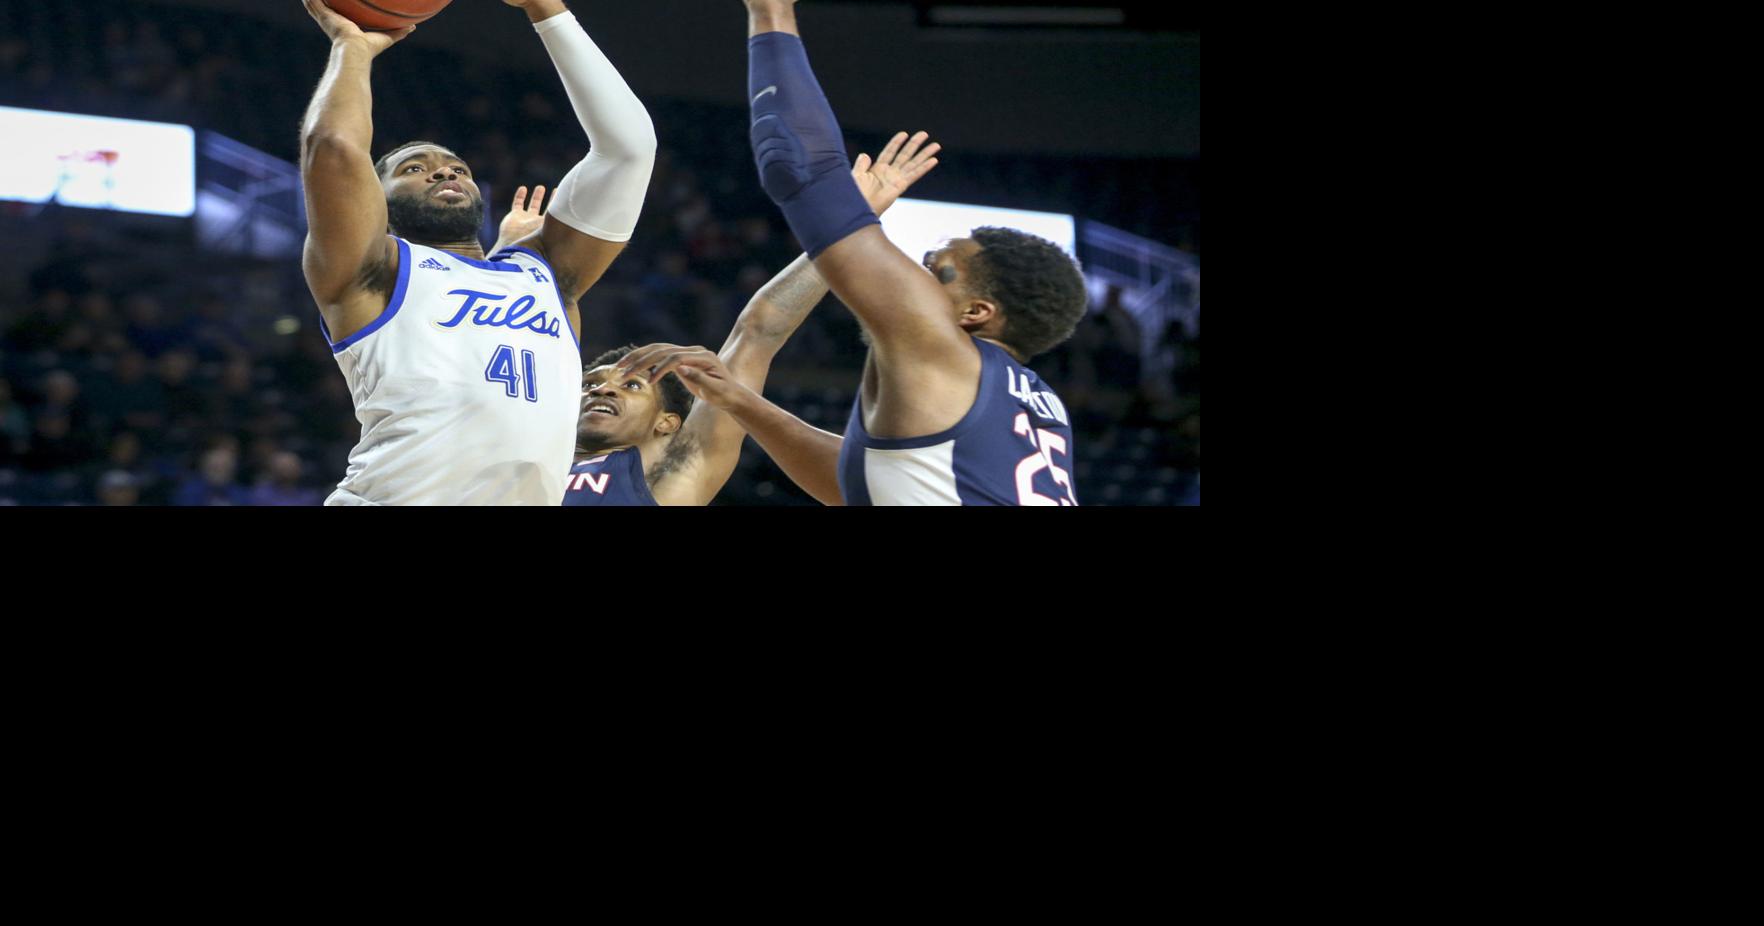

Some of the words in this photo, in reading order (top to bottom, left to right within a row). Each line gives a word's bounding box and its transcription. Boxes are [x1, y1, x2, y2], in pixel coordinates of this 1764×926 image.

[437, 289, 560, 338] Tulsa
[485, 345, 538, 402] 41
[1013, 412, 1079, 506] 25
